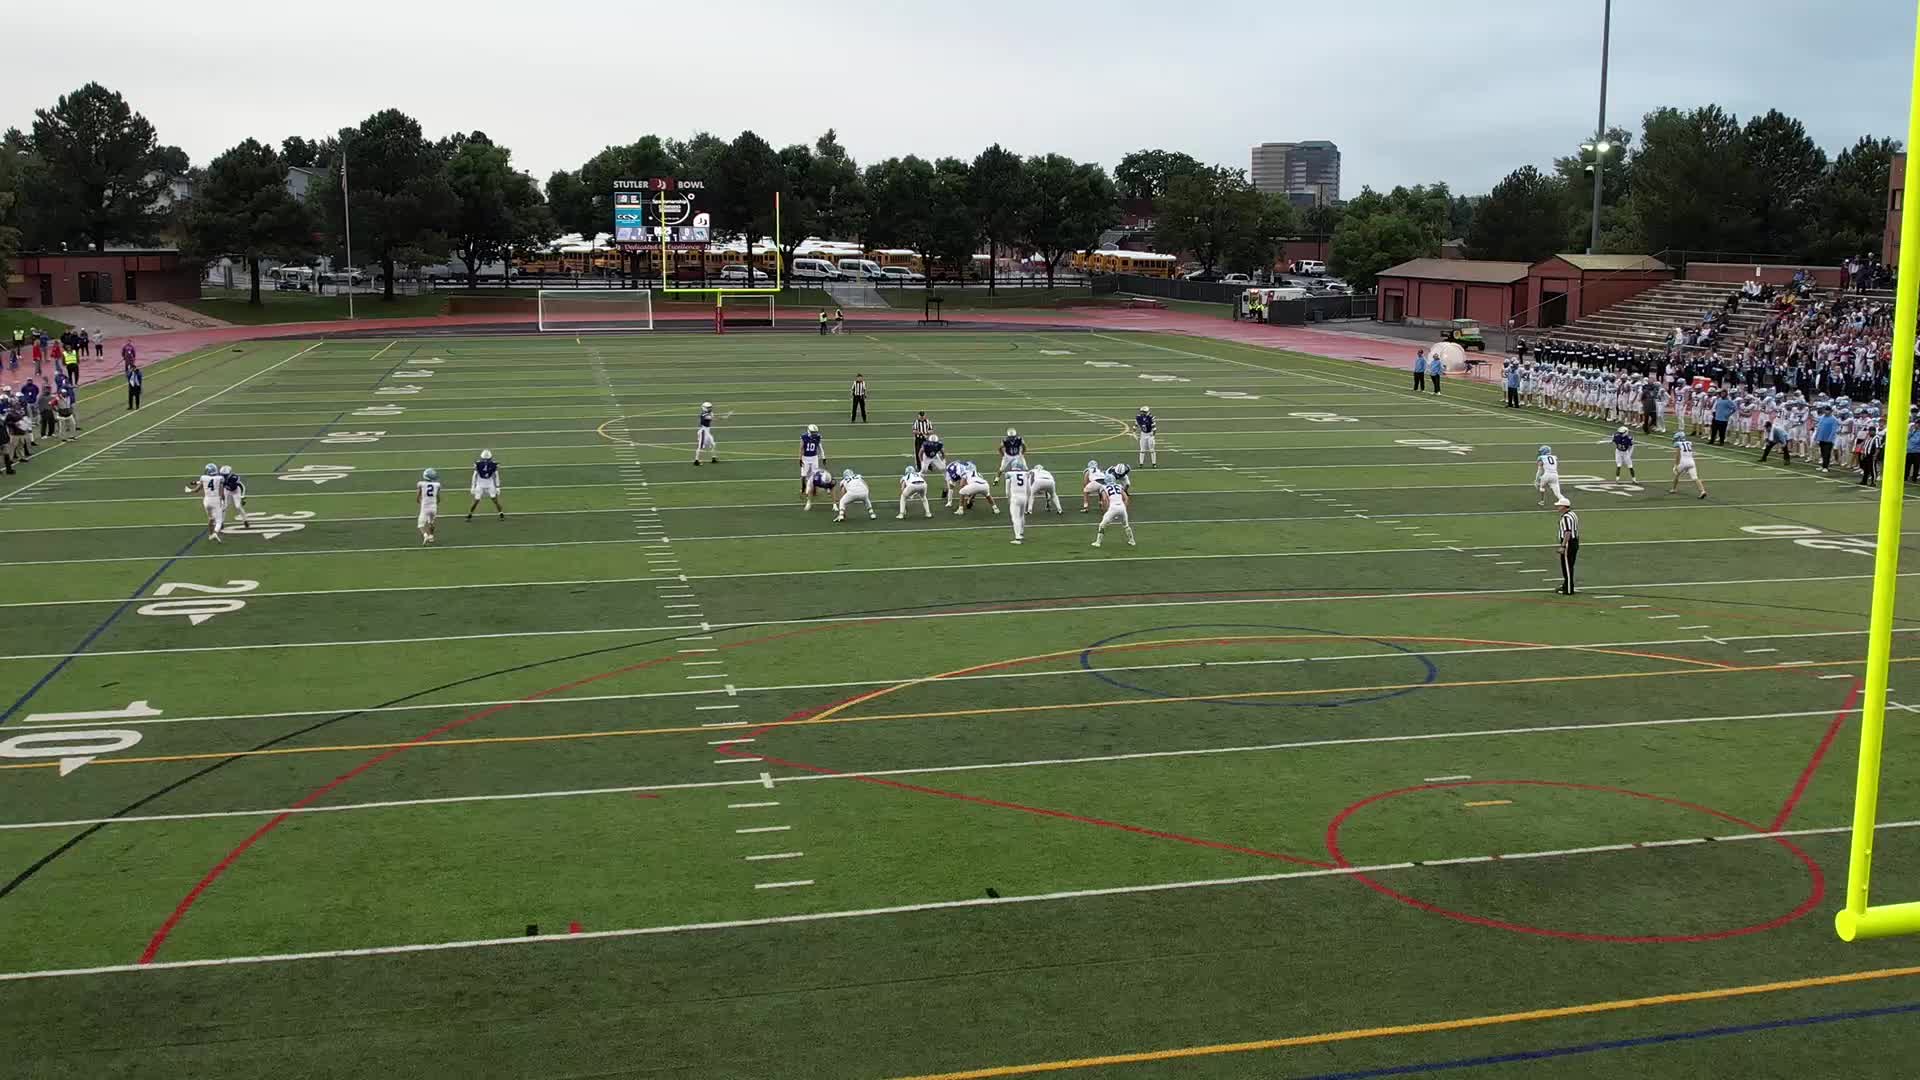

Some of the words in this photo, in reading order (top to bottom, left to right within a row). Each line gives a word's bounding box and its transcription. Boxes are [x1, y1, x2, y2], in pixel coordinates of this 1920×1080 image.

[613, 180, 649, 189] STUTLER
[678, 180, 705, 189] BOWL
[1547, 456, 1554, 465] 0
[207, 479, 215, 491] 4
[1016, 474, 1024, 486] 5
[427, 484, 435, 497] 2
[1106, 484, 1121, 496] 26
[137, 579, 260, 616] 20
[0, 699, 164, 758] 10
